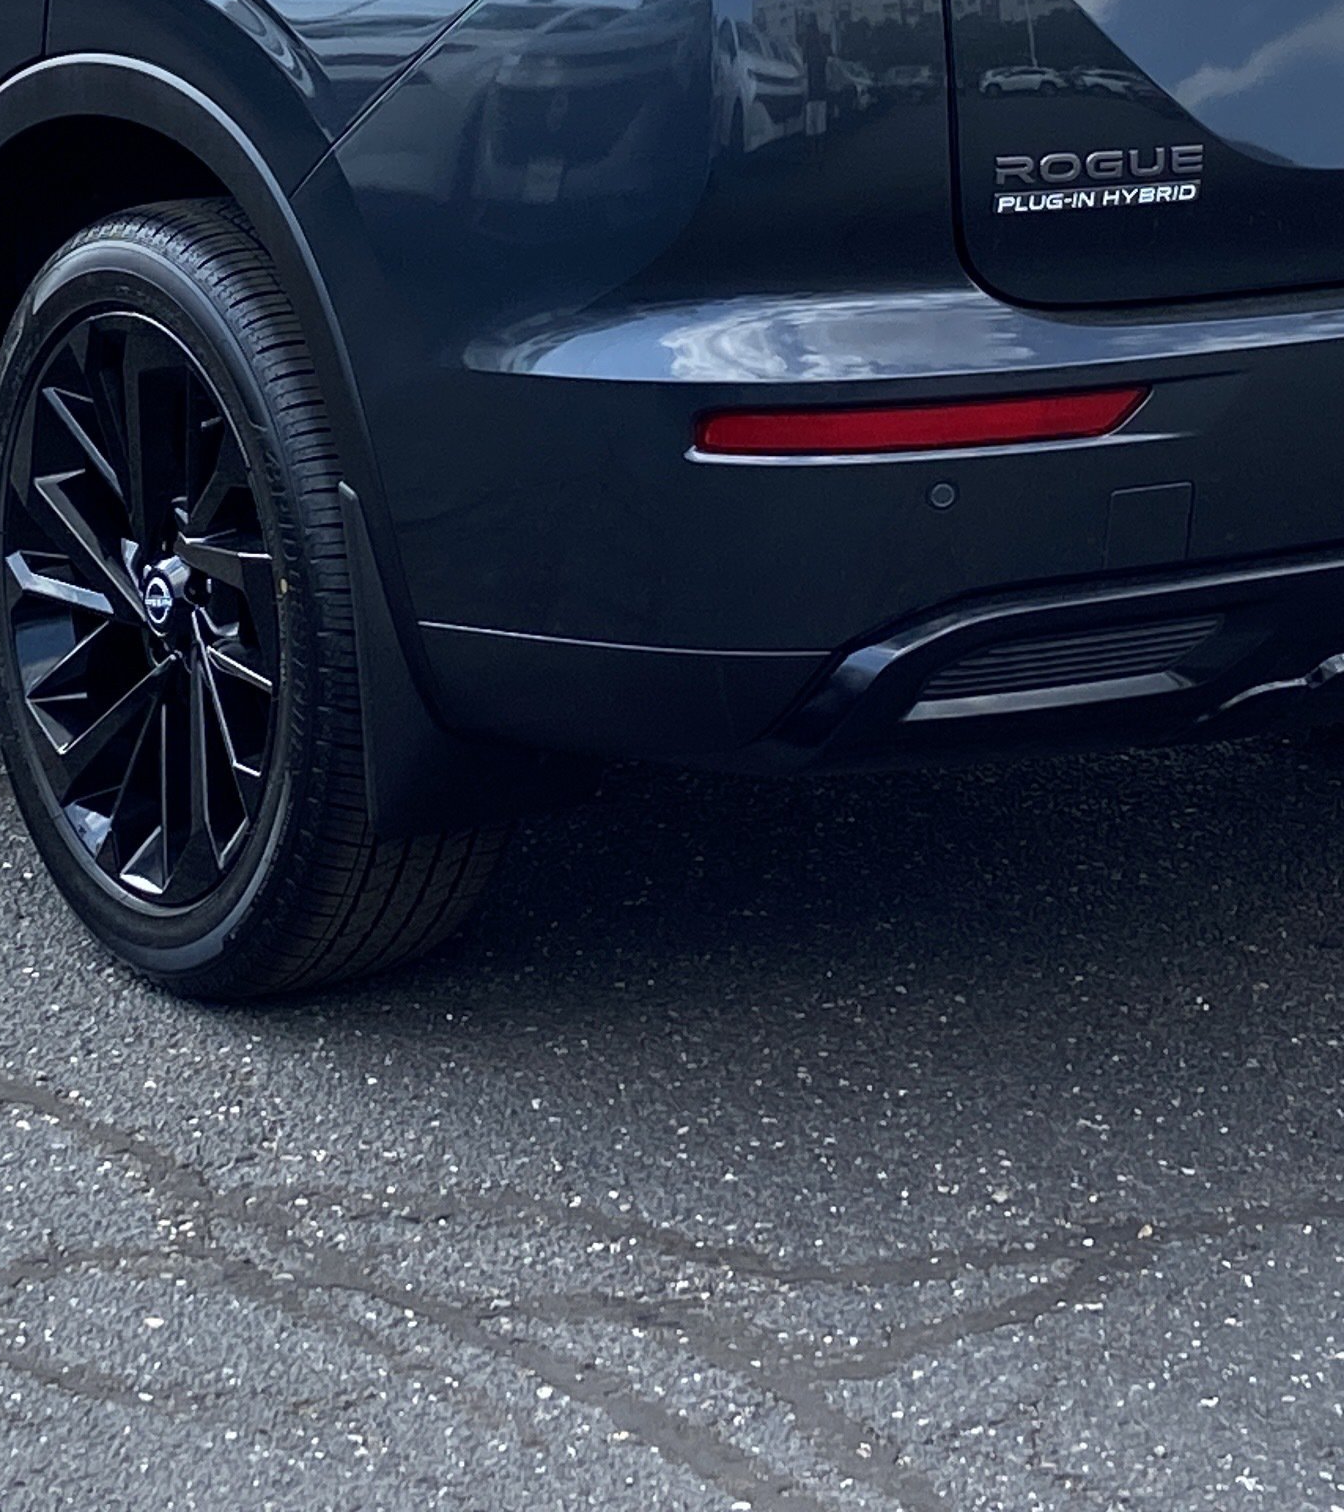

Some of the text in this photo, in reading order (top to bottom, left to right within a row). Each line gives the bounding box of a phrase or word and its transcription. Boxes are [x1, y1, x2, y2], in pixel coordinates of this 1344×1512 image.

[995, 144, 1204, 185] ROGUE
[997, 184, 1197, 213] PLUG-IN HYBRID
